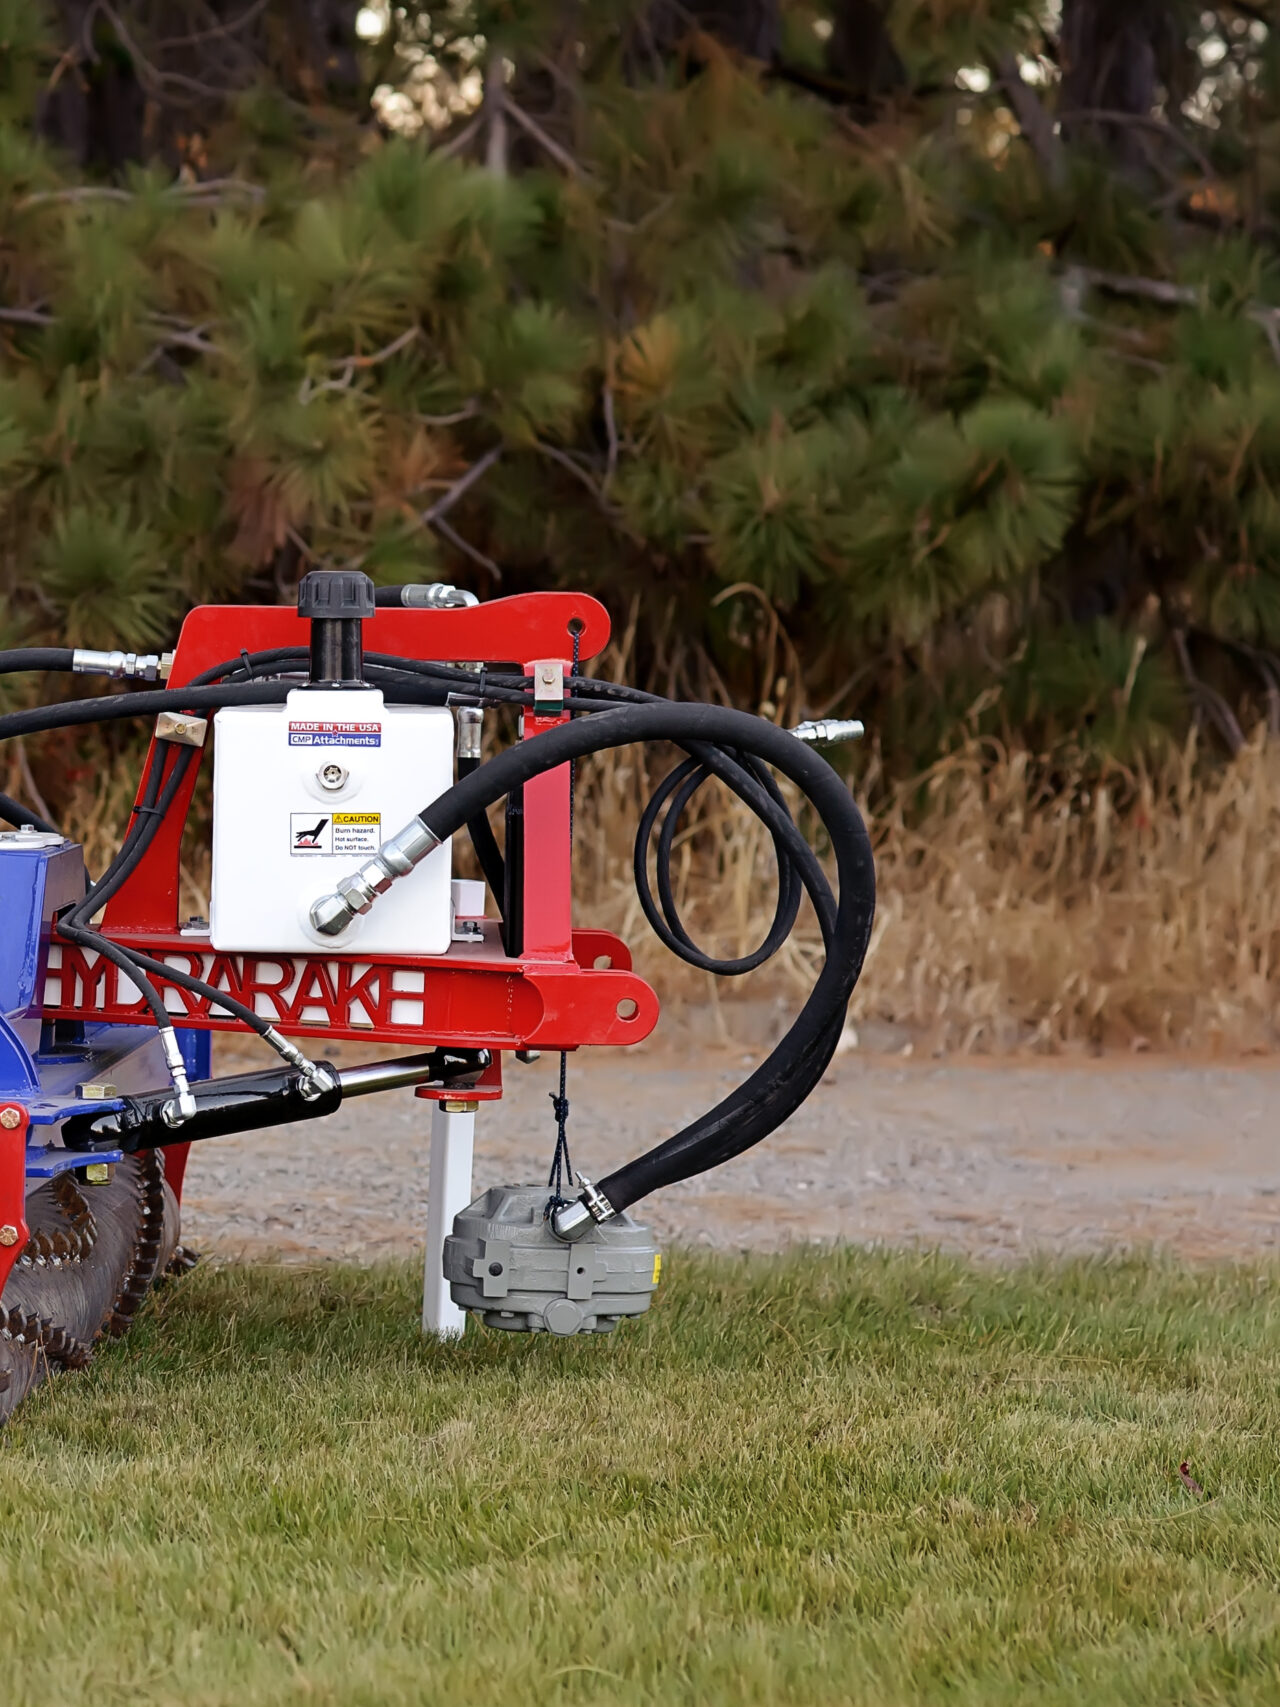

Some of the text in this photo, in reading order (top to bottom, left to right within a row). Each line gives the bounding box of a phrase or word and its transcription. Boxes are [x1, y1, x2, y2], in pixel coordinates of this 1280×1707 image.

[291, 722, 380, 732] MADE IN THE USA
[292, 735, 312, 743] CMP
[313, 735, 376, 745] Attachments
[343, 815, 379, 823] CAUTION
